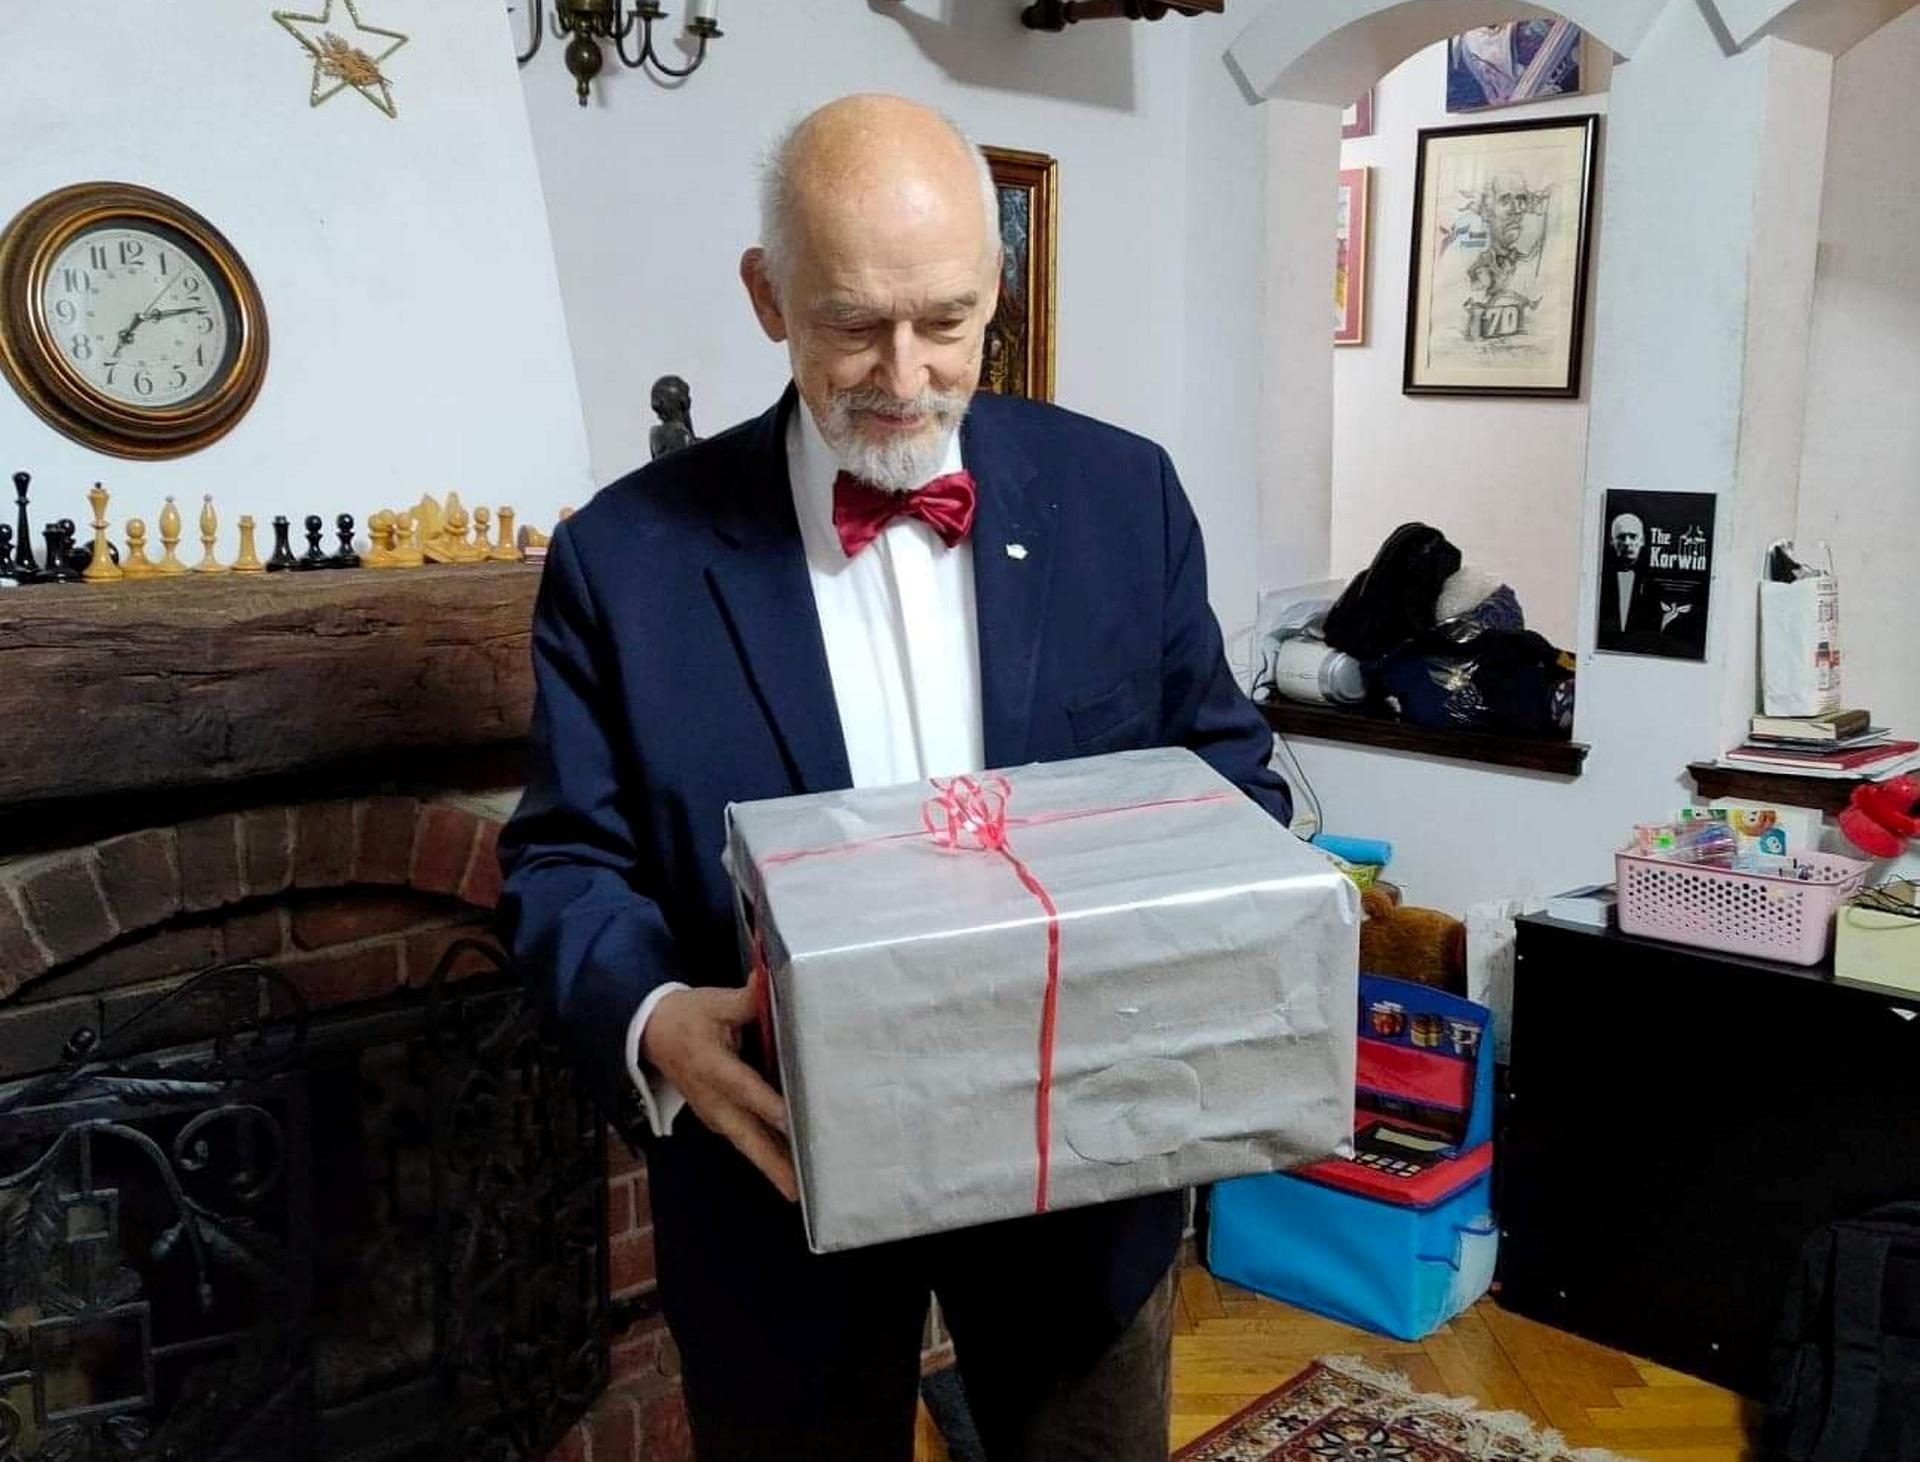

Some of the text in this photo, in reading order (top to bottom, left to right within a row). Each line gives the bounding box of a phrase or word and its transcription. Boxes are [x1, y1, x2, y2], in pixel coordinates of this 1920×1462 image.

[90, 245, 107, 270] 11
[119, 240, 144, 265] 12
[159, 252, 167, 275] 1
[64, 267, 90, 292] 10
[183, 276, 200, 300] 2
[56, 299, 76, 325] 9
[1482, 305, 1519, 337] 70
[73, 334, 92, 359] 8
[103, 361, 118, 384] 7
[134, 370, 153, 396] 6
[168, 364, 187, 390] 5
[1650, 527, 1671, 545] The
[1649, 546, 1706, 571] Korwin
